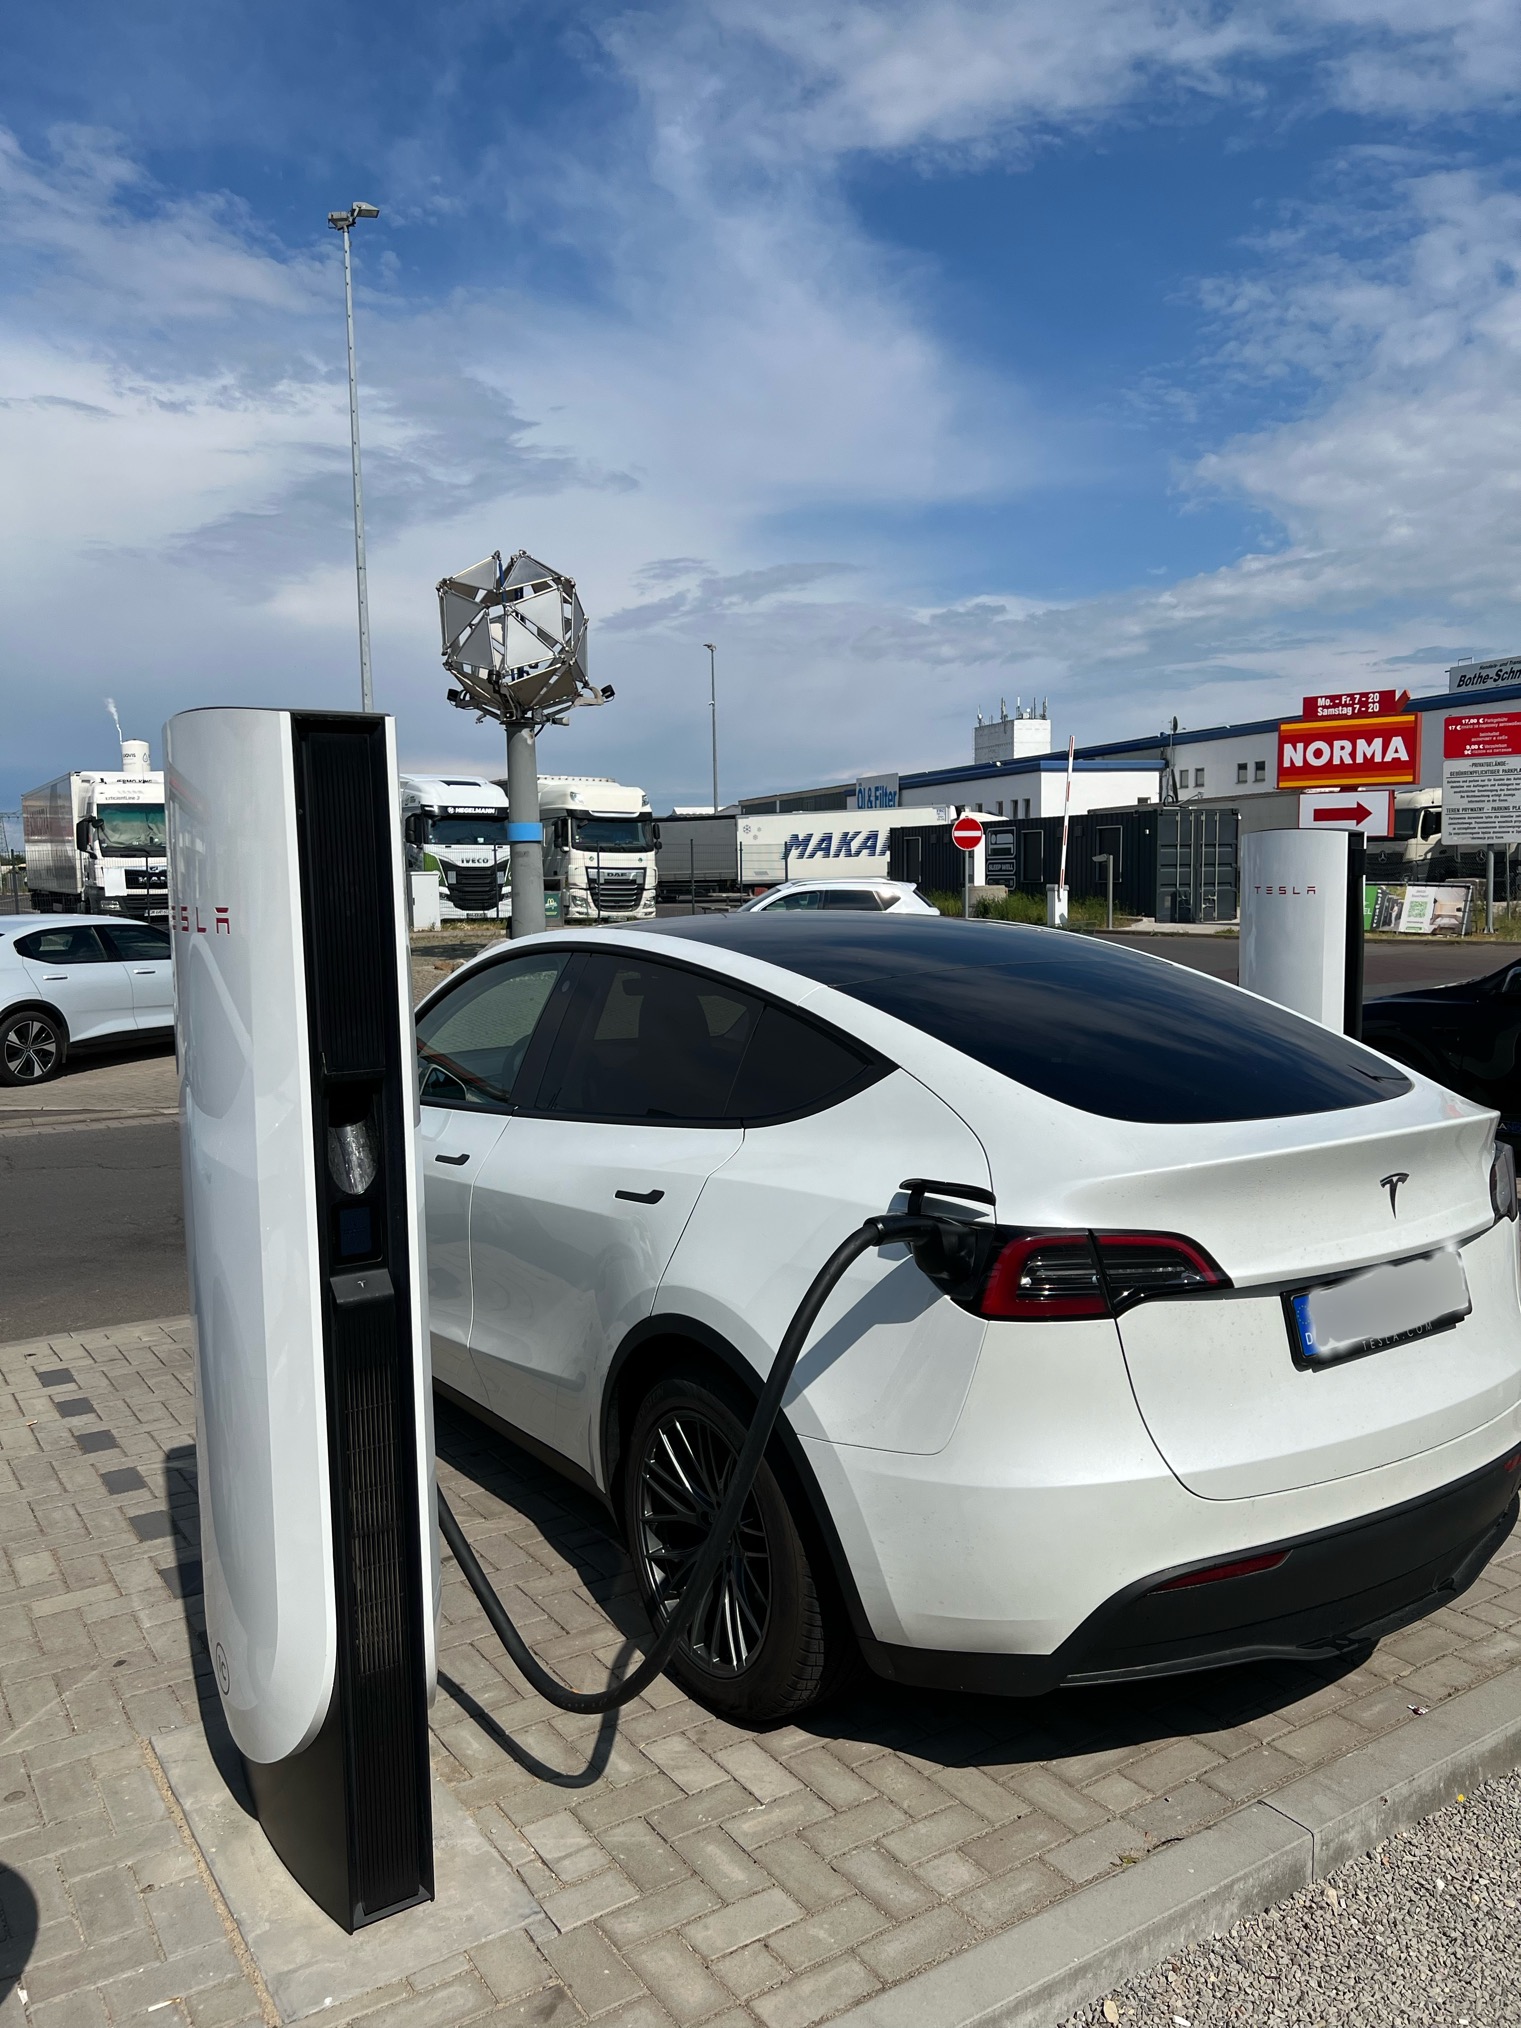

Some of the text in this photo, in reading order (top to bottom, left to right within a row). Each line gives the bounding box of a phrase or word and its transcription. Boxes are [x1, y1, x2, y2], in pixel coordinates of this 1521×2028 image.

[1317, 697, 1333, 706] Mo.
[1341, 696, 1352, 704] Fr.
[1354, 694, 1360, 703] 7
[1368, 692, 1379, 702] 20
[1317, 706, 1352, 716] Samstag
[1354, 704, 1360, 713] 7
[1368, 703, 1379, 712] 20
[1283, 736, 1409, 768] NORMA
[857, 782, 897, 809] Öl & Filter
[1254, 885, 1316, 895] TESLA
[171, 906, 230, 934] ESLA
[1306, 1332, 1314, 1345] D
[1363, 1322, 1433, 1351] TESLA.COM
